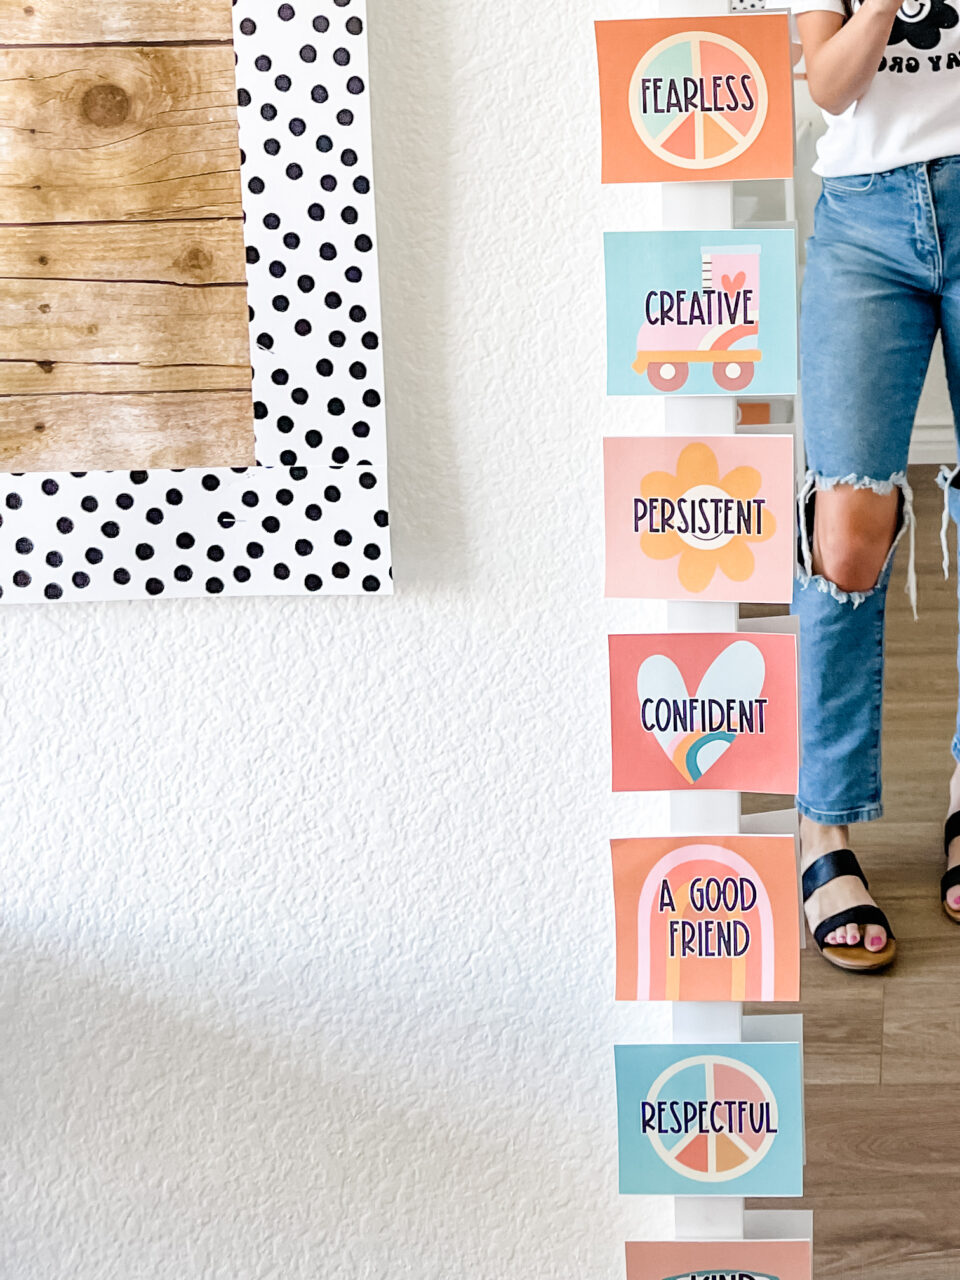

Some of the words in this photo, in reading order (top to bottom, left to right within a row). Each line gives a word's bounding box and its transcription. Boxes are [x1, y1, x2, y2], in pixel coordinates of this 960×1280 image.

[641, 74, 755, 113] FEARLESS
[645, 289, 755, 326] CREATIVE
[633, 497, 765, 535] PERSISTENT
[641, 698, 767, 733] CONFIDENT
[659, 879, 676, 913] A
[689, 877, 757, 912] GOOD
[669, 920, 750, 957] FRIEND
[641, 1101, 777, 1134] RESPECTFUL
